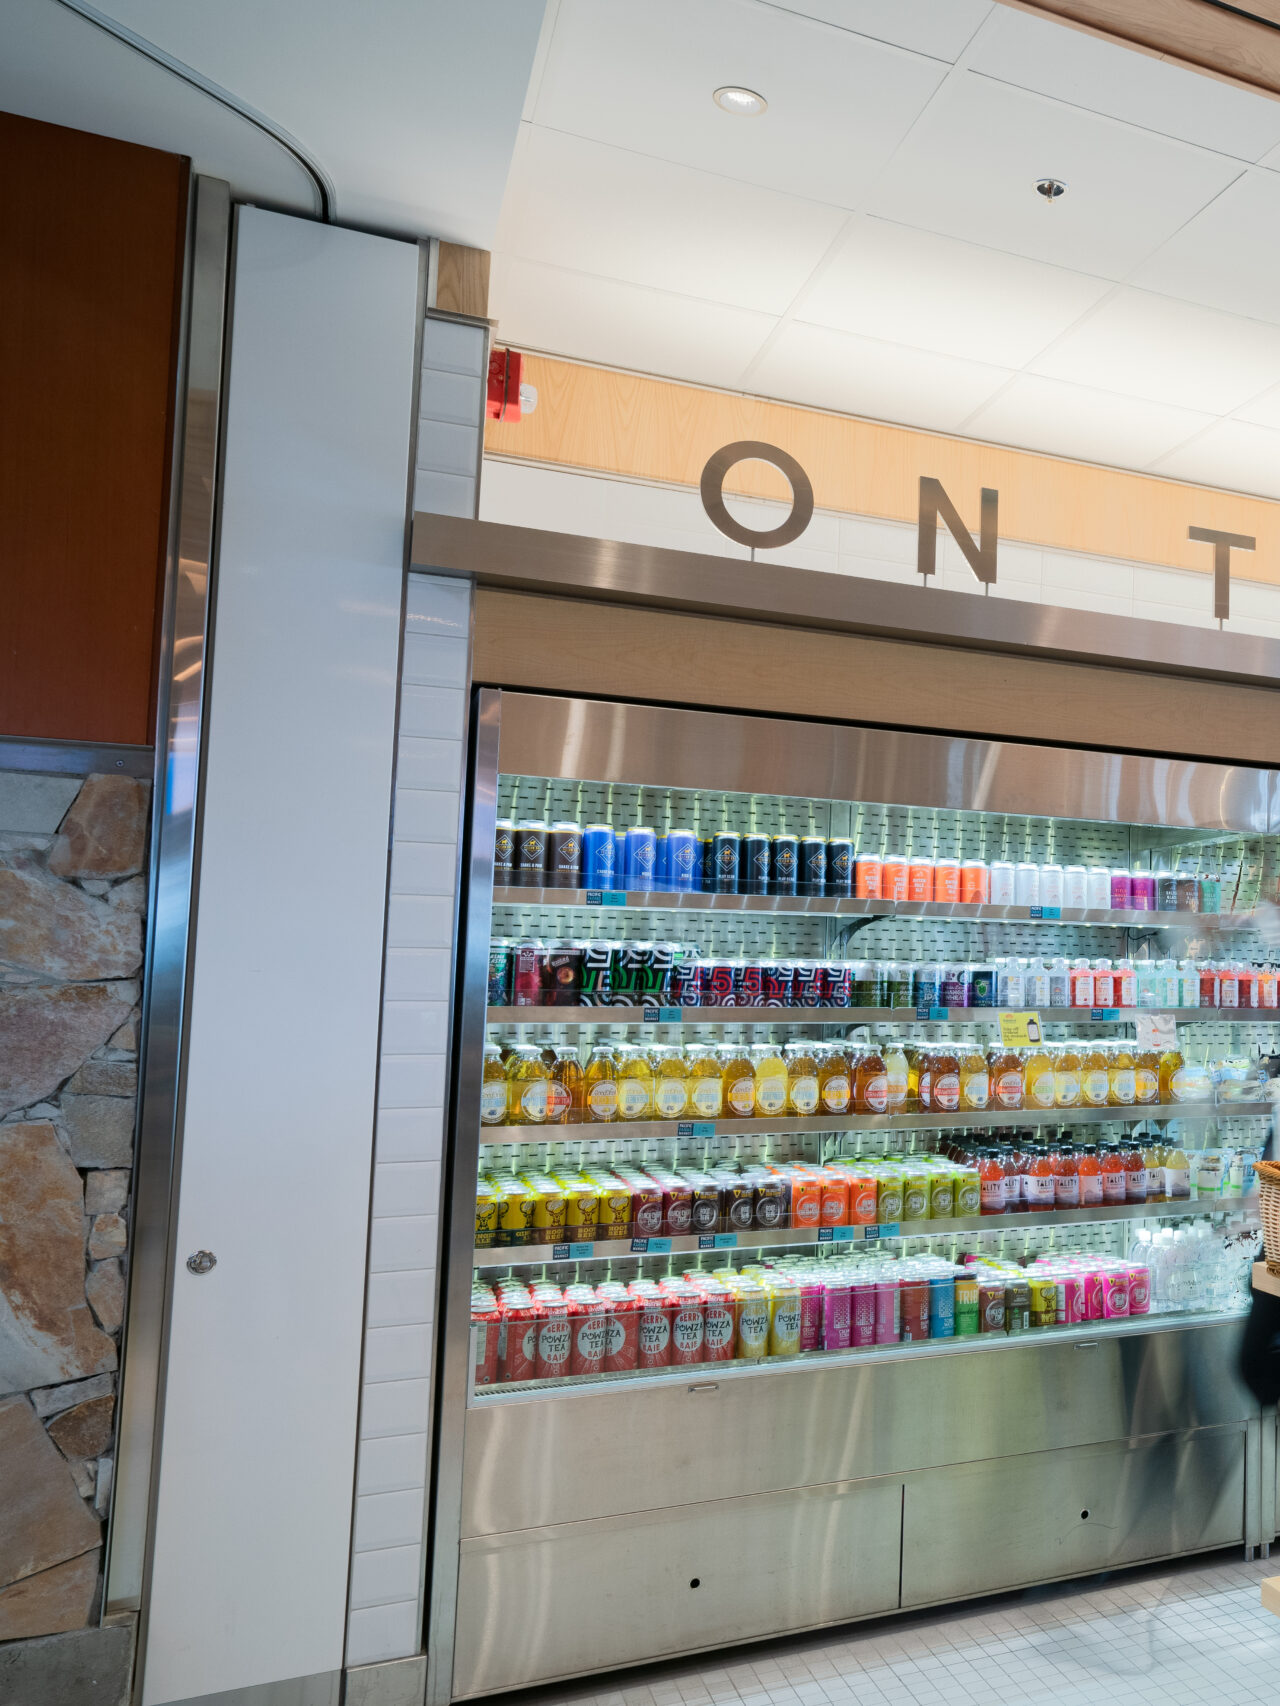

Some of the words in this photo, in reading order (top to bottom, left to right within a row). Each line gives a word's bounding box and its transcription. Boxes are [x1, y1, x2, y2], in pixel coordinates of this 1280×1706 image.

[700, 440, 998, 584] ON
[642, 1313, 664, 1324] BERRY
[679, 1311, 700, 1323] BERRY
[705, 1308, 726, 1319] BERRY
[547, 1321, 569, 1333] BERRY
[748, 1326, 764, 1334] TEA
[786, 1322, 799, 1331] TEA
[541, 1331, 571, 1344] POWZA
[581, 1330, 606, 1342] POWZ
[681, 1332, 697, 1340] TEA
[707, 1329, 723, 1337] TEA
[644, 1335, 660, 1343] TEA
[549, 1343, 565, 1352] TEA
